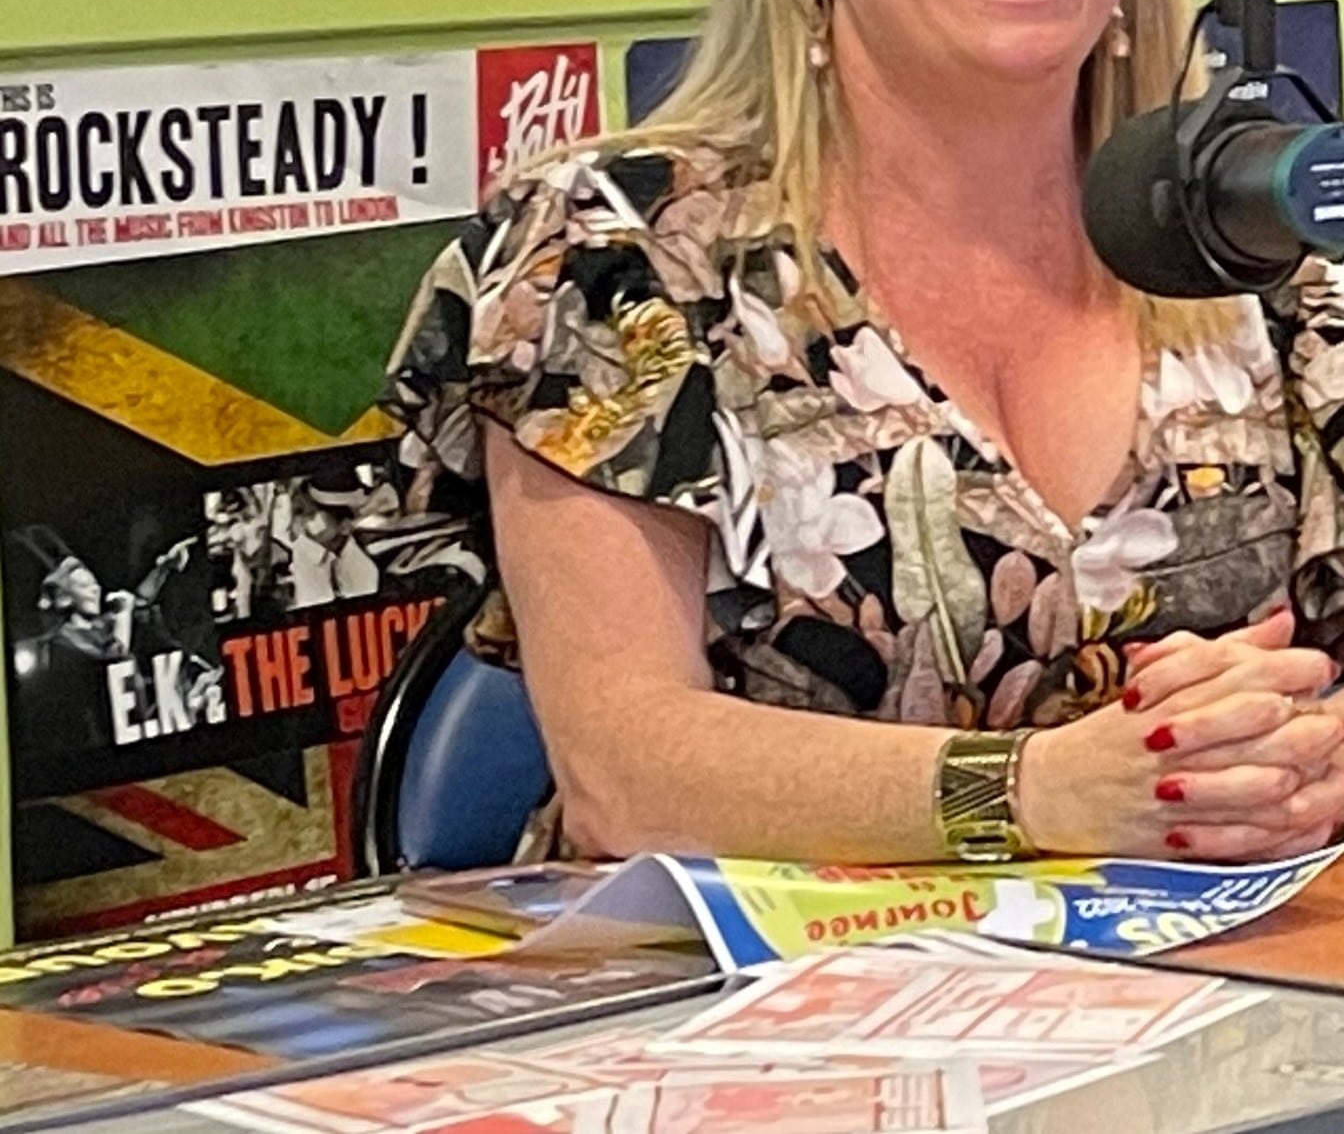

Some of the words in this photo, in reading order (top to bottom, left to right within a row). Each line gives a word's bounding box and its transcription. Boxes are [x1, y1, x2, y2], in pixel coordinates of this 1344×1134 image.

[35, 83, 55, 112] IS
[0, 95, 387, 215] ROCKSTEADY
[411, 92, 428, 185] !
[37, 220, 69, 250] ALL
[76, 216, 107, 245] THE
[114, 213, 173, 243] MUSIC
[177, 208, 224, 238] FROM
[229, 200, 309, 233] KINGSTON
[313, 199, 334, 226] TO
[339, 195, 399, 225] LONDON
[222, 624, 315, 718] THE
[804, 890, 989, 950] Journée
